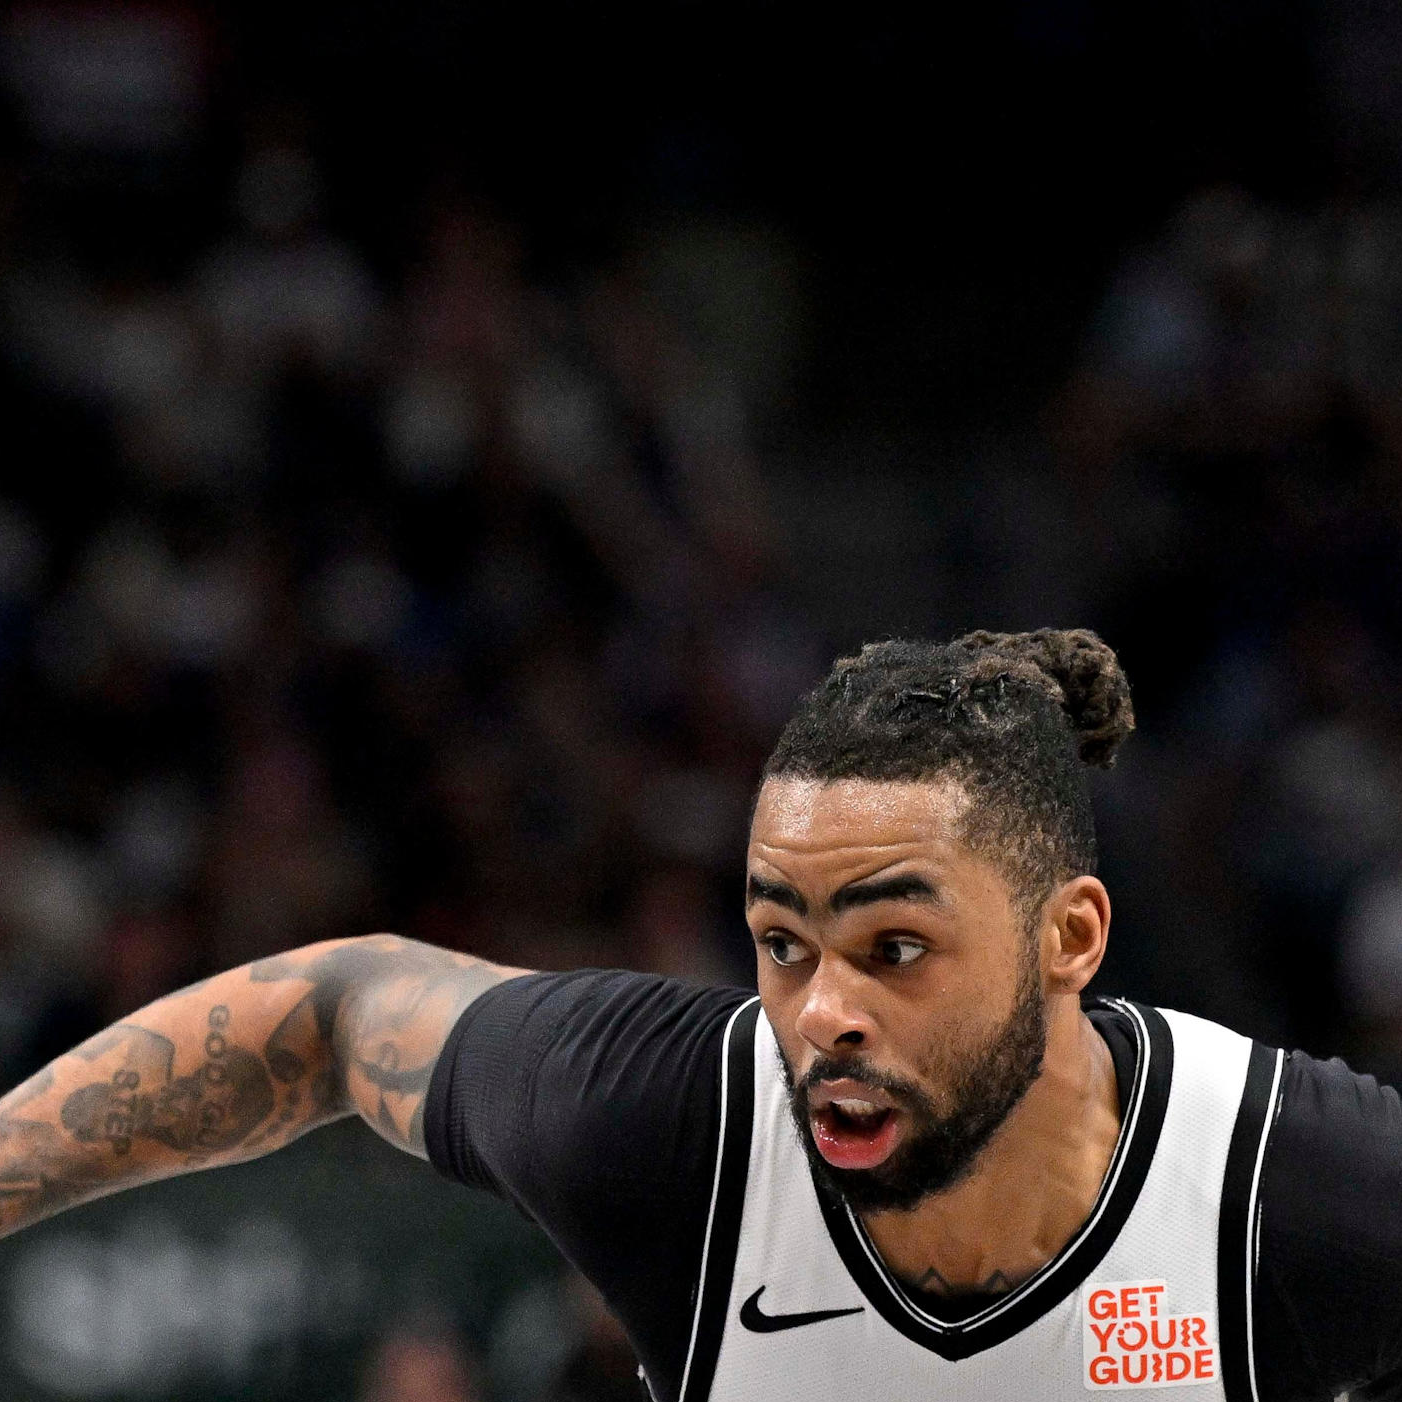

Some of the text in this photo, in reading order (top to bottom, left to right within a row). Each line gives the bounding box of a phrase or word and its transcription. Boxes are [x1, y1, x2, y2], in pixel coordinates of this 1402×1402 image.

[1088, 1286, 1165, 1320] GET
[1089, 1317, 1208, 1353] YOUR
[1089, 1348, 1214, 1385] GUIDE
